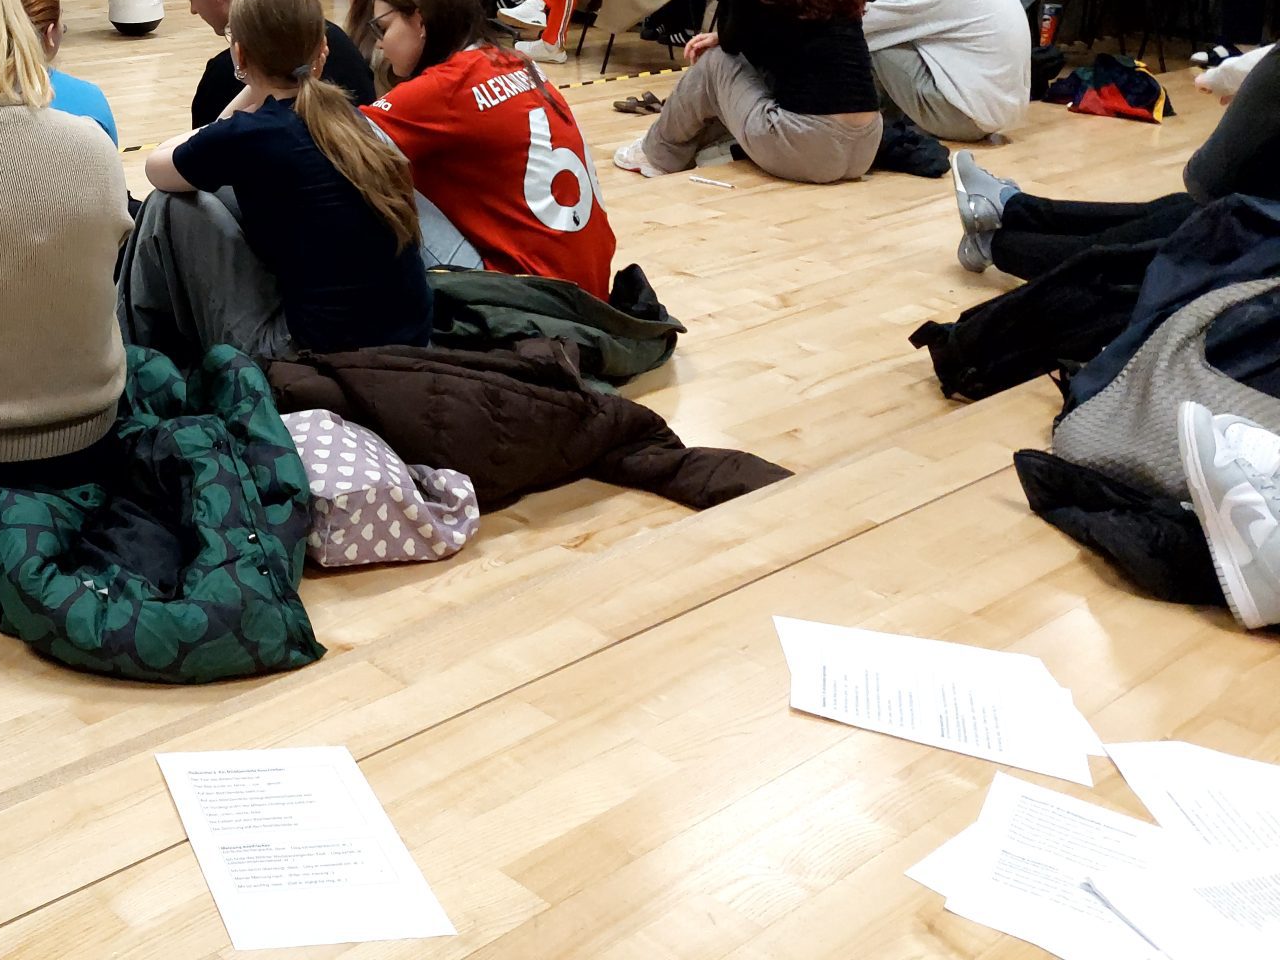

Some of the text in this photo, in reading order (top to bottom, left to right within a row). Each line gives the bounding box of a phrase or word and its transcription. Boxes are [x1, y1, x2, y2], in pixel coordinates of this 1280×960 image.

[372, 98, 393, 112] dia
[471, 60, 549, 112] ALEXAND
[524, 107, 606, 233] 6
